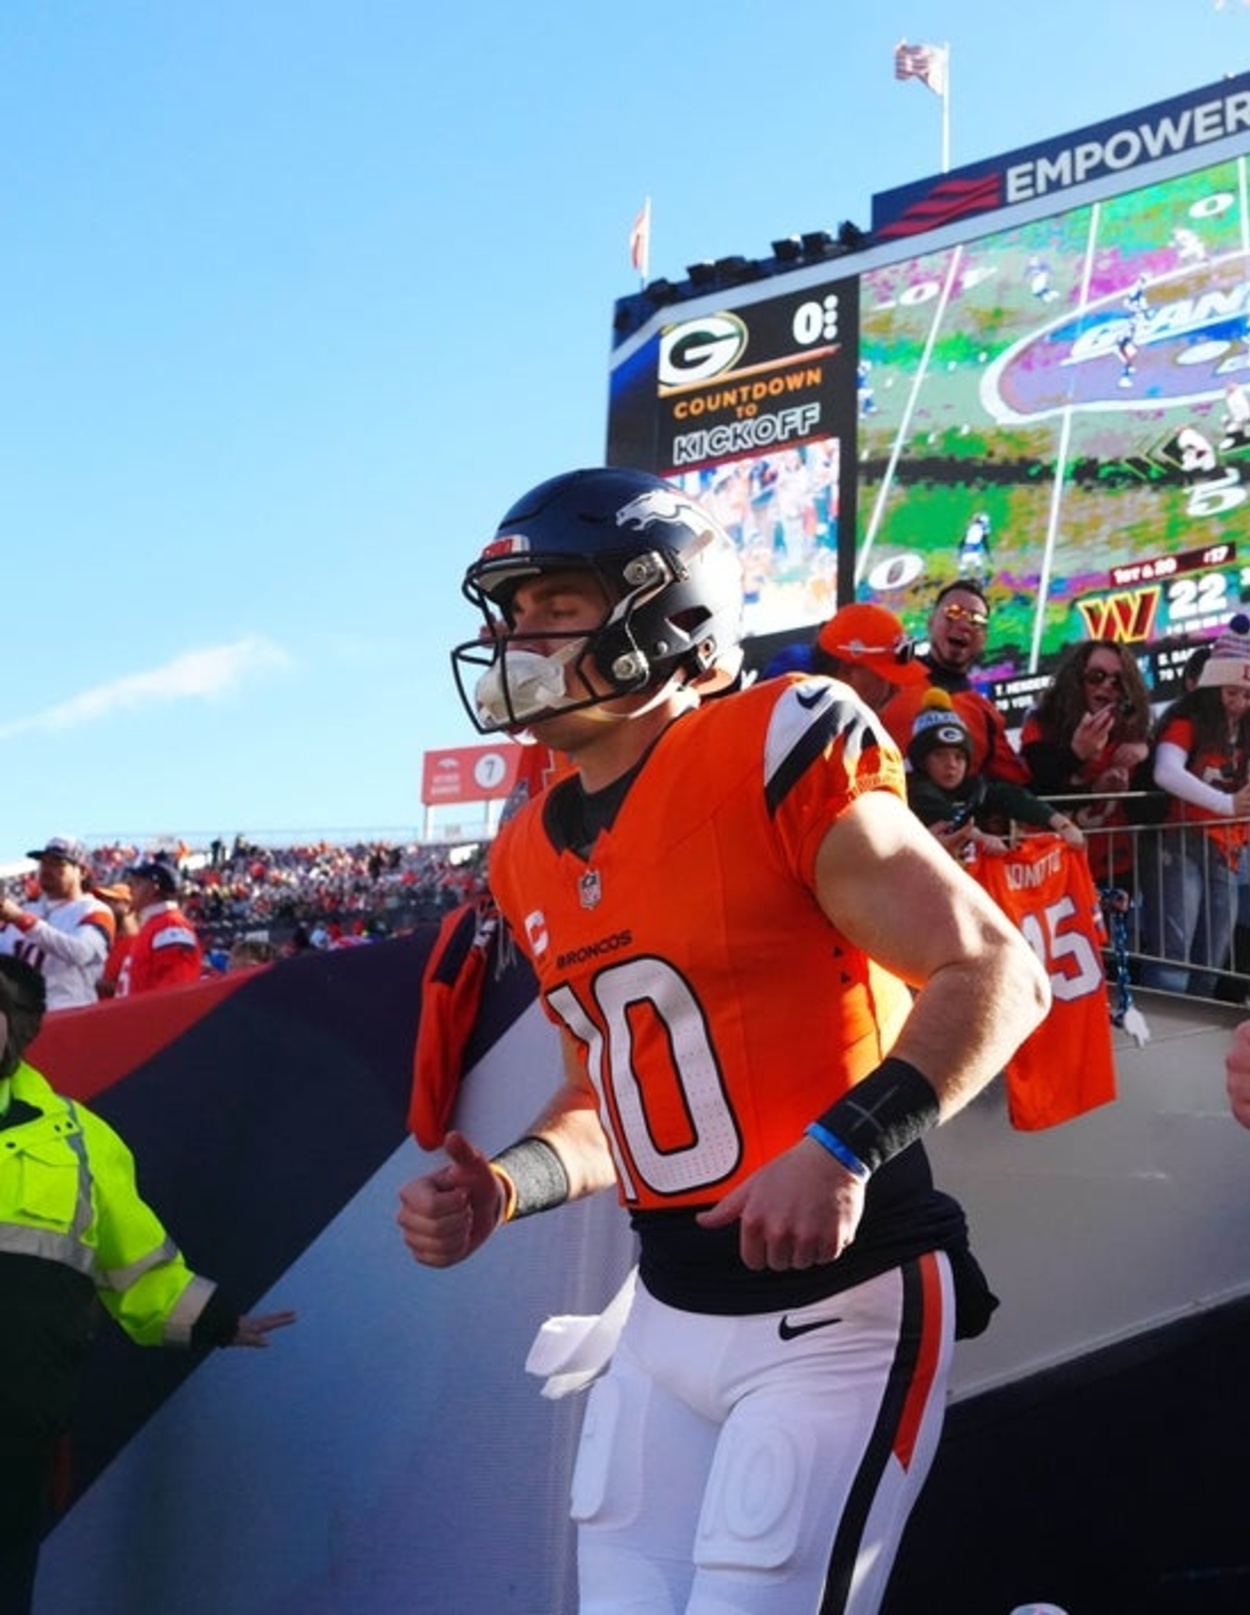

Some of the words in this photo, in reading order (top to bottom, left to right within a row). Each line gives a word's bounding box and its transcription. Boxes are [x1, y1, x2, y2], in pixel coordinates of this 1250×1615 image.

[673, 368, 823, 419] COUNTDOWN
[736, 403, 758, 419] TO
[673, 402, 821, 465] KICKOFF
[1168, 572, 1228, 620] 22
[484, 759, 496, 782] 7
[524, 909, 549, 956] C
[557, 928, 633, 969] BRONCOS
[544, 953, 745, 1204] 10
